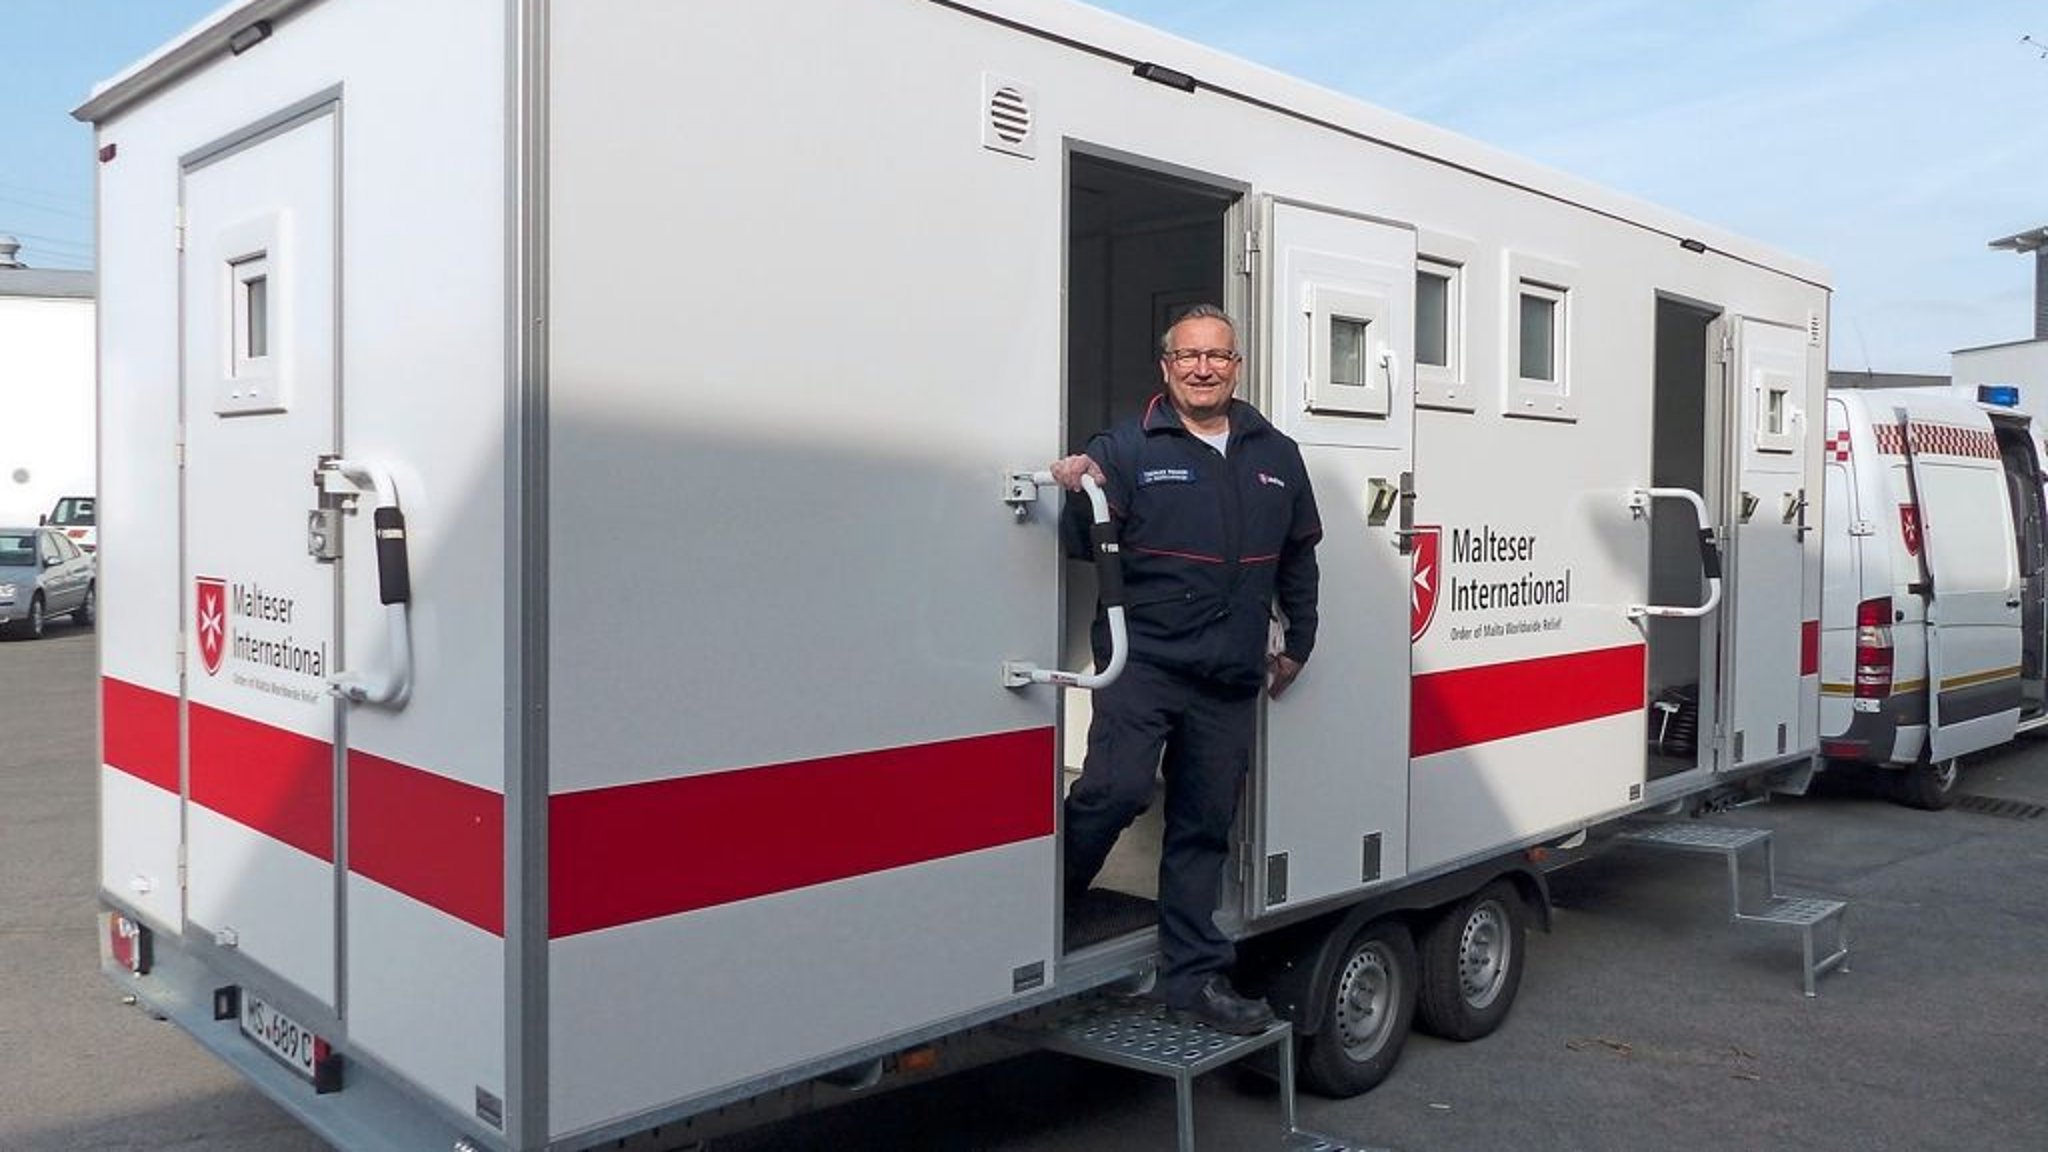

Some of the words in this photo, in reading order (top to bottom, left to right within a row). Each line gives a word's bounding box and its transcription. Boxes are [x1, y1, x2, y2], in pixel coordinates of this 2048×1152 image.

[1453, 525, 1535, 562] Malteser
[233, 583, 293, 623] Malteser
[1451, 569, 1570, 611] International
[1450, 627, 1473, 641] Order
[1483, 623, 1504, 637] Malta
[233, 627, 326, 678] International
